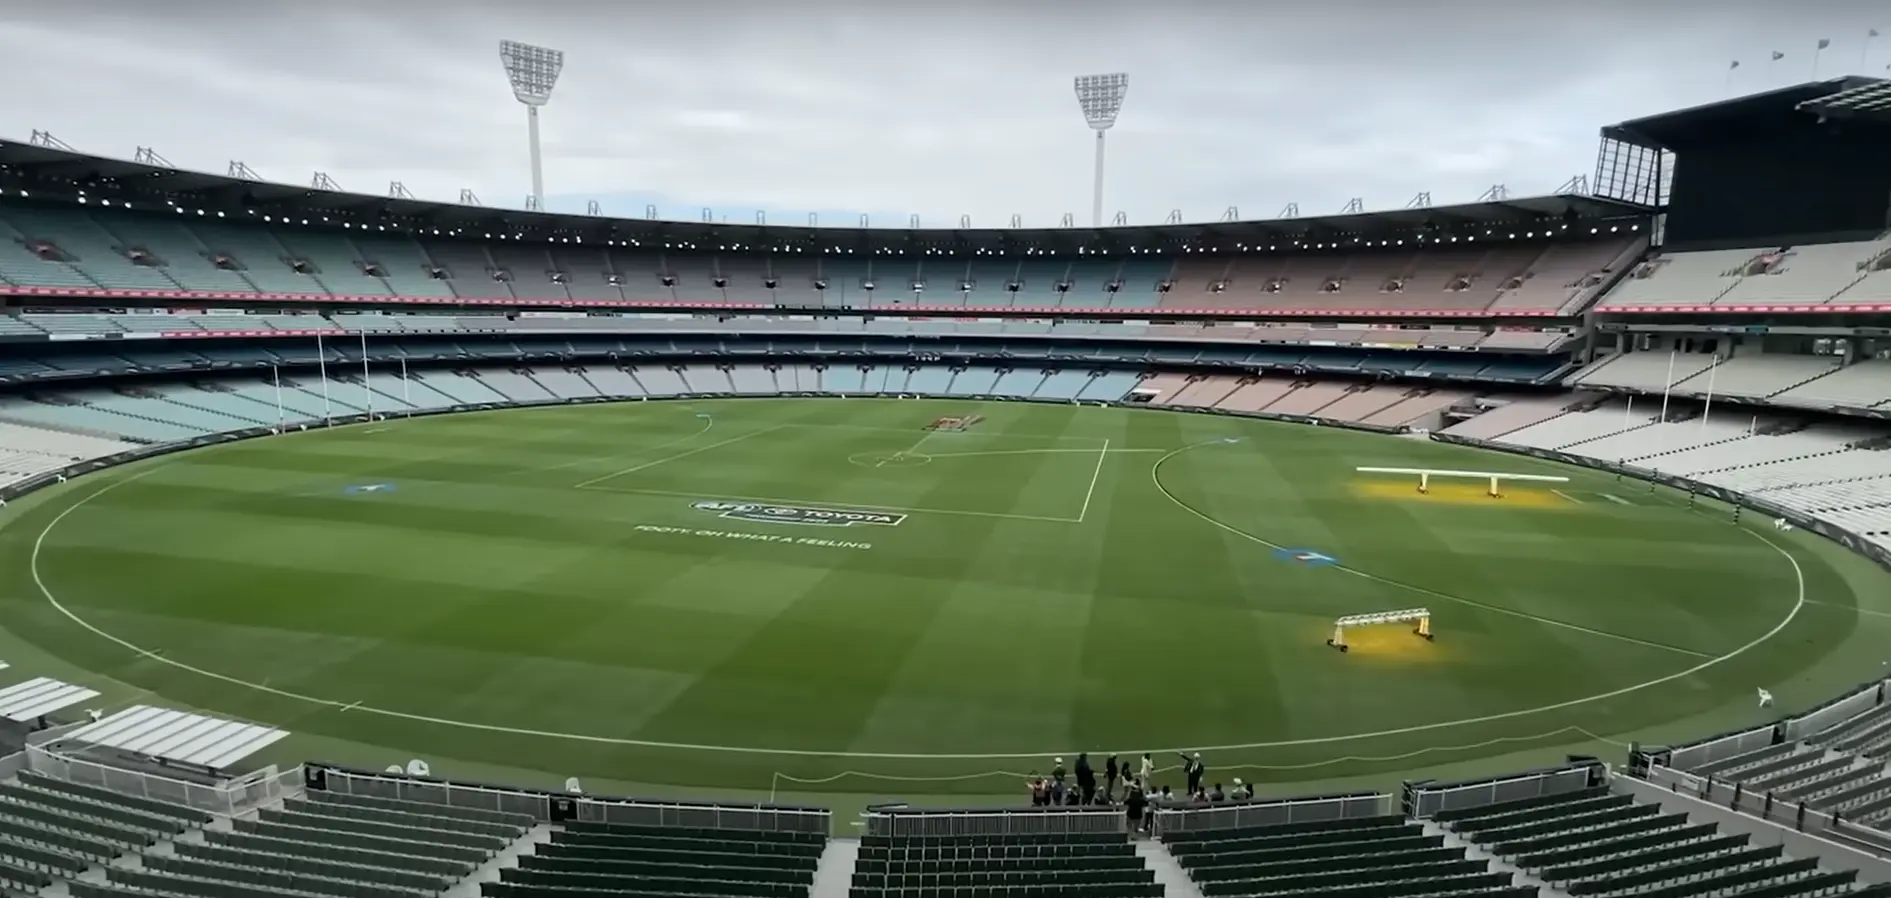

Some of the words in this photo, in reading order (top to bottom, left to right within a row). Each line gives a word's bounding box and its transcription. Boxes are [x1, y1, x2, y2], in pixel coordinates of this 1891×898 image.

[804, 510, 891, 522] TOYOTA
[726, 532, 780, 541] WHAT
[796, 538, 872, 549] FEELING
